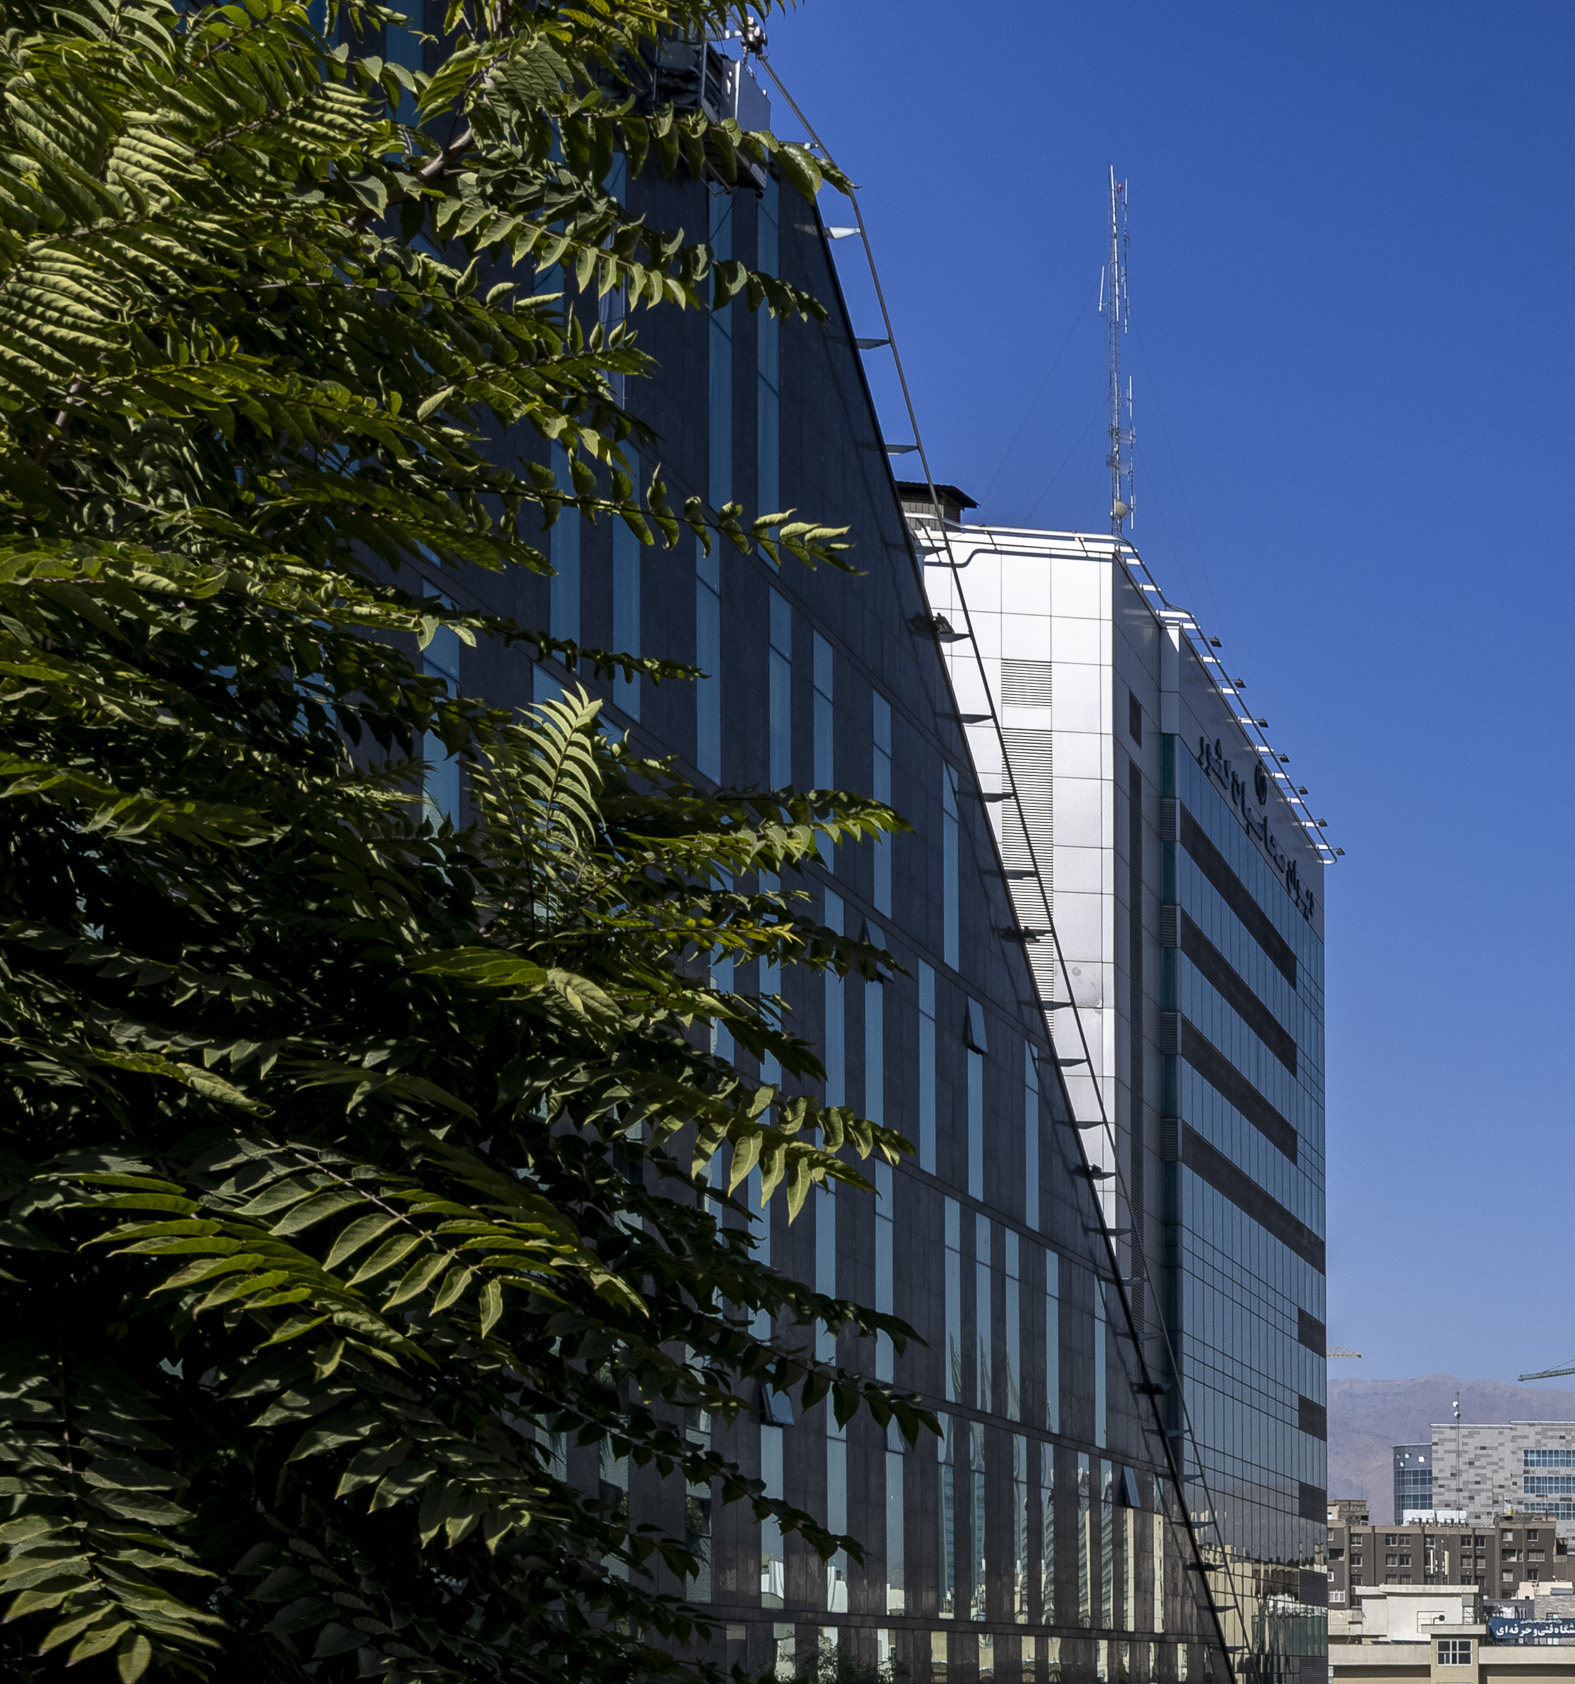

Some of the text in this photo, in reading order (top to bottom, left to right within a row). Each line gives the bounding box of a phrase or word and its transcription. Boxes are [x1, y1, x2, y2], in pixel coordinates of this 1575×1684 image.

[1198, 736, 1315, 922] دیوان محاسبات کشور
